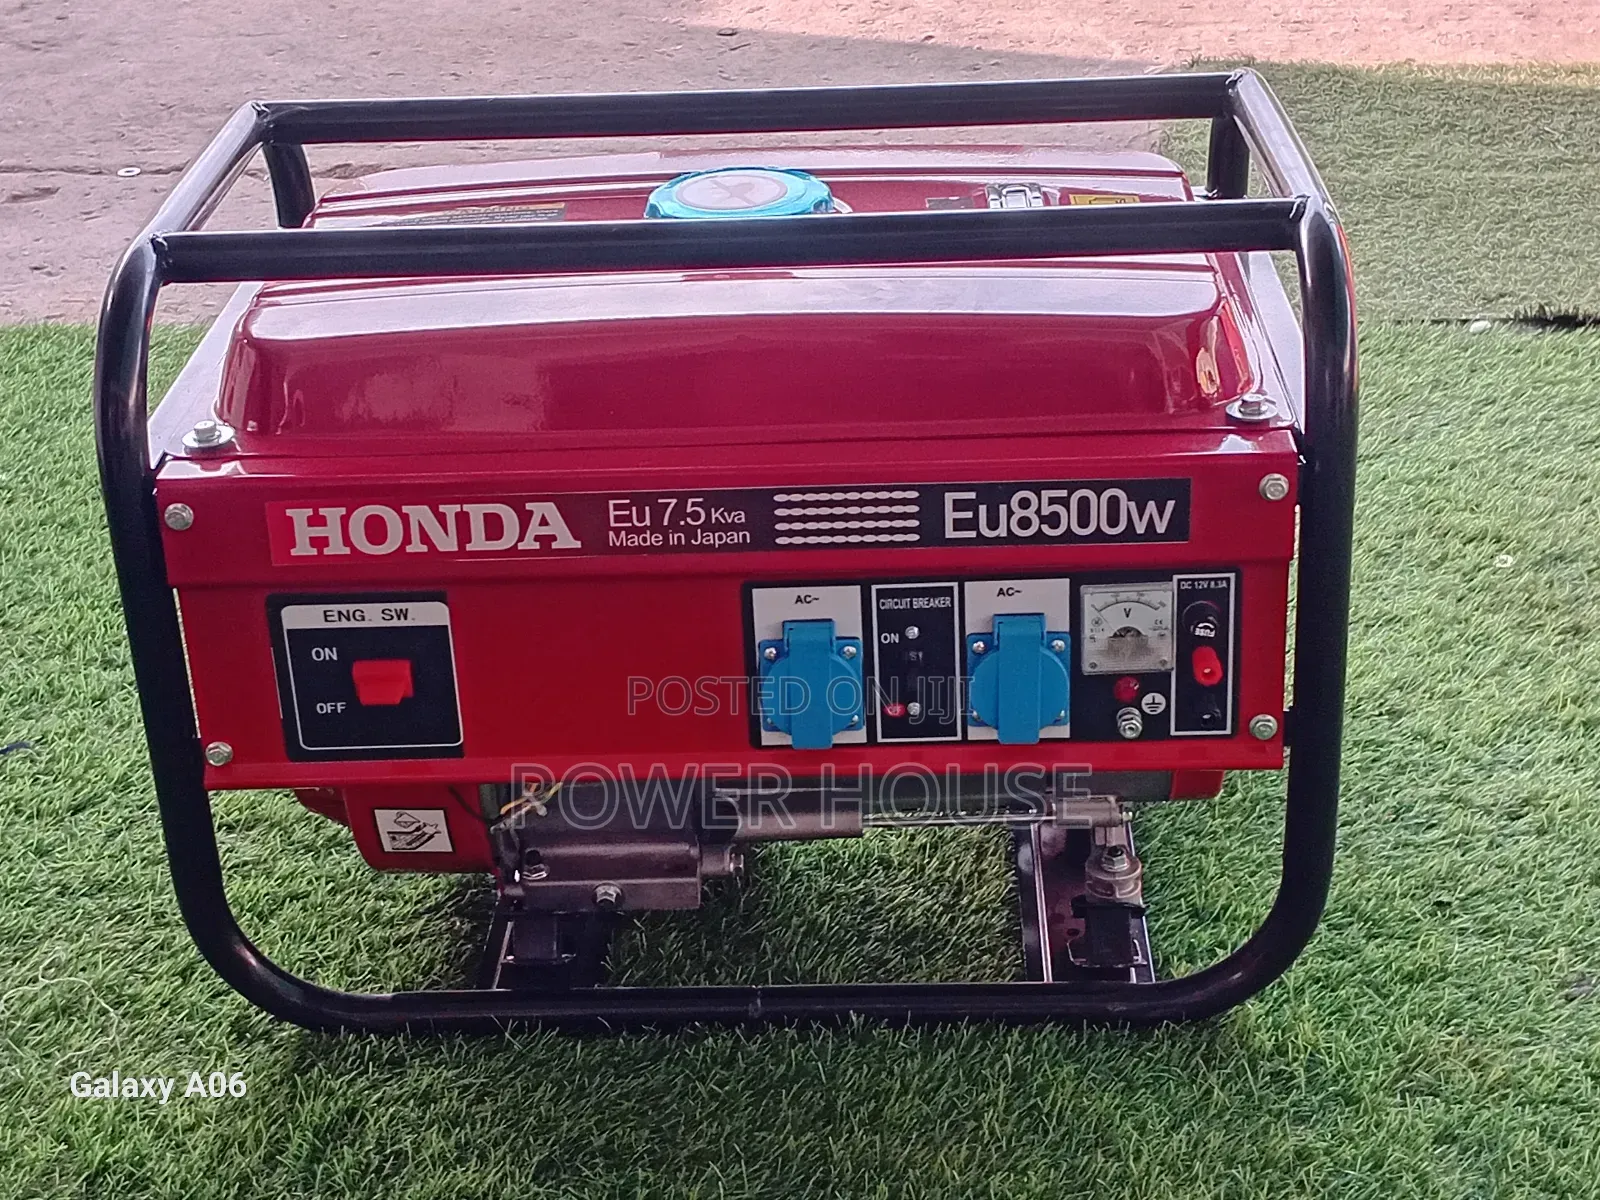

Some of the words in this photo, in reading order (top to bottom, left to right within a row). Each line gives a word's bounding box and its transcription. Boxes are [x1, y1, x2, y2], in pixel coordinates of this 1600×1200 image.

[608, 499, 651, 527] Eu
[657, 498, 706, 526] 7.5
[711, 507, 746, 524] Kva
[944, 487, 1176, 539] Eu8500w
[285, 502, 582, 556] HONDA
[608, 530, 663, 546] Made
[669, 530, 685, 546] in
[691, 528, 751, 548] Japan
[1180, 581, 1193, 590] DC
[1194, 580, 1209, 589] 12V
[879, 598, 911, 610] CIRCUIT
[913, 596, 952, 609] BREAKER
[323, 609, 373, 623] ENG.
[1123, 608, 1132, 618] V
[881, 633, 900, 644] ON
[1195, 628, 1215, 637] FUSE
[311, 647, 338, 661] ON
[316, 702, 347, 714] OFF
